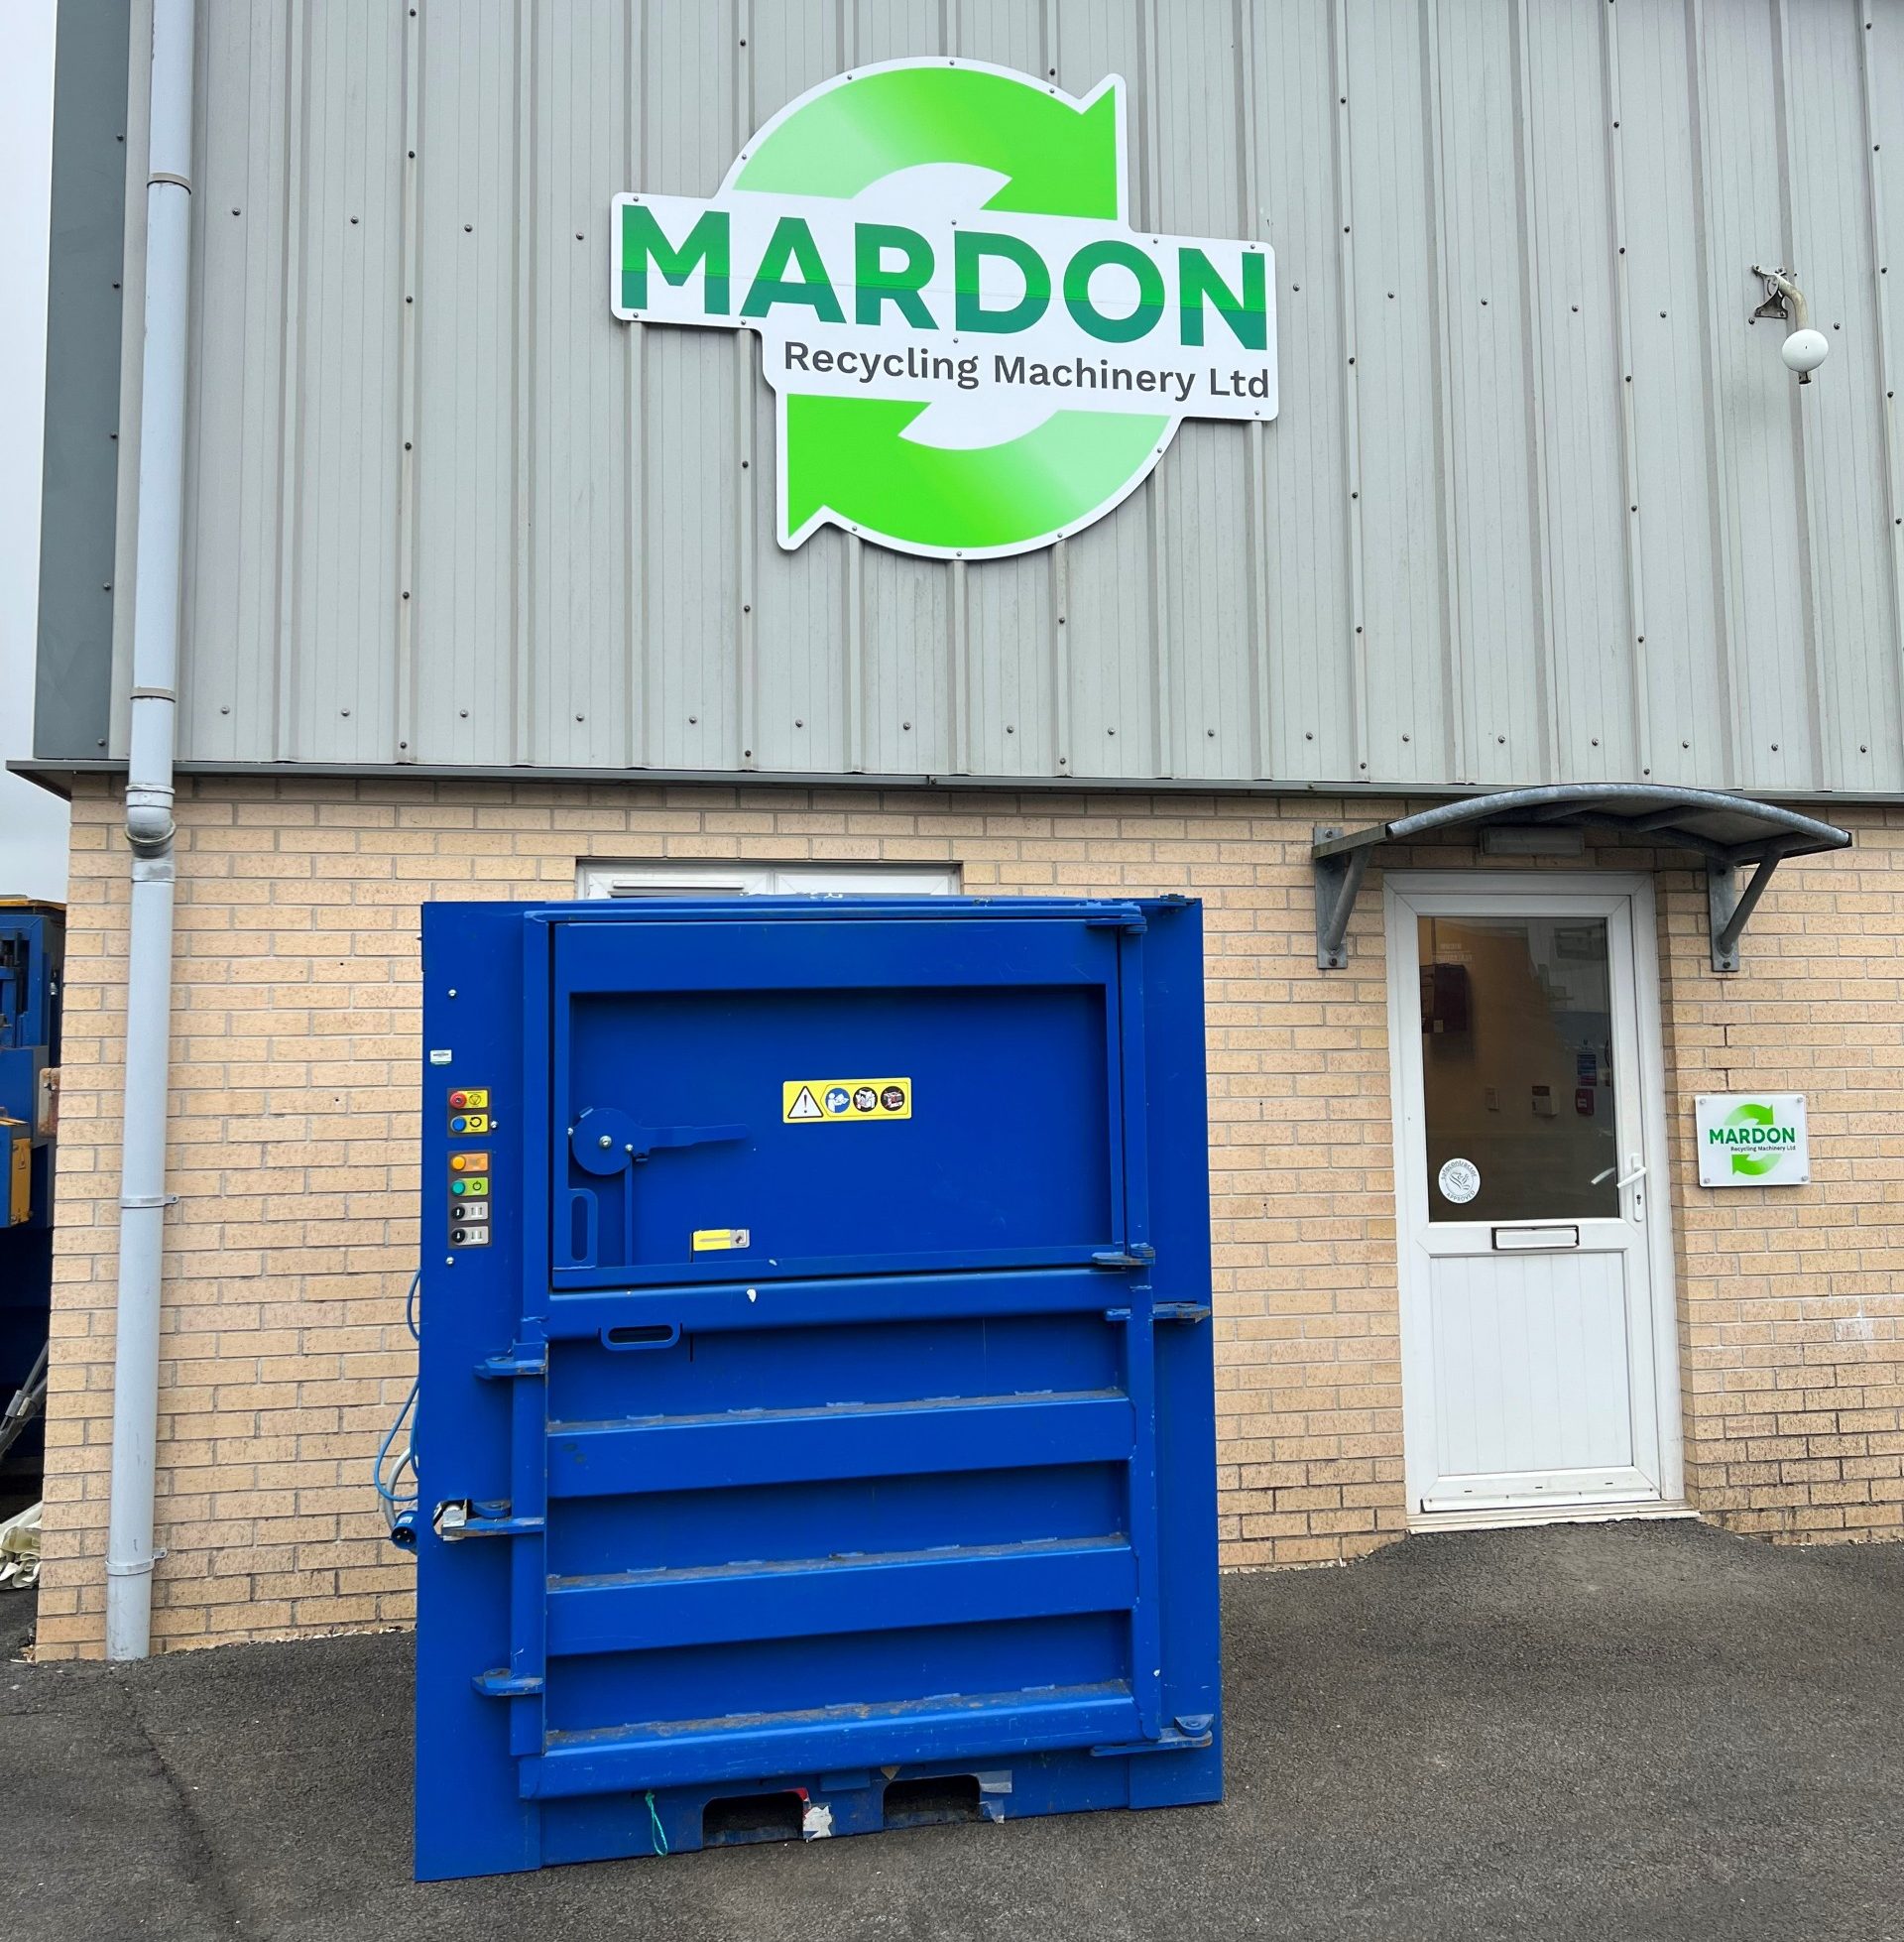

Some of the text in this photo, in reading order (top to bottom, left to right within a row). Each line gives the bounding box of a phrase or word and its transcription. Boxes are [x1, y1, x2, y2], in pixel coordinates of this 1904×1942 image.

[622, 204, 1266, 350] MARDON
[784, 341, 1269, 401] Recycling Machinery Ltd
[1709, 1128, 1796, 1144] MARDON
[1446, 1190, 1475, 1201] APPROVED
